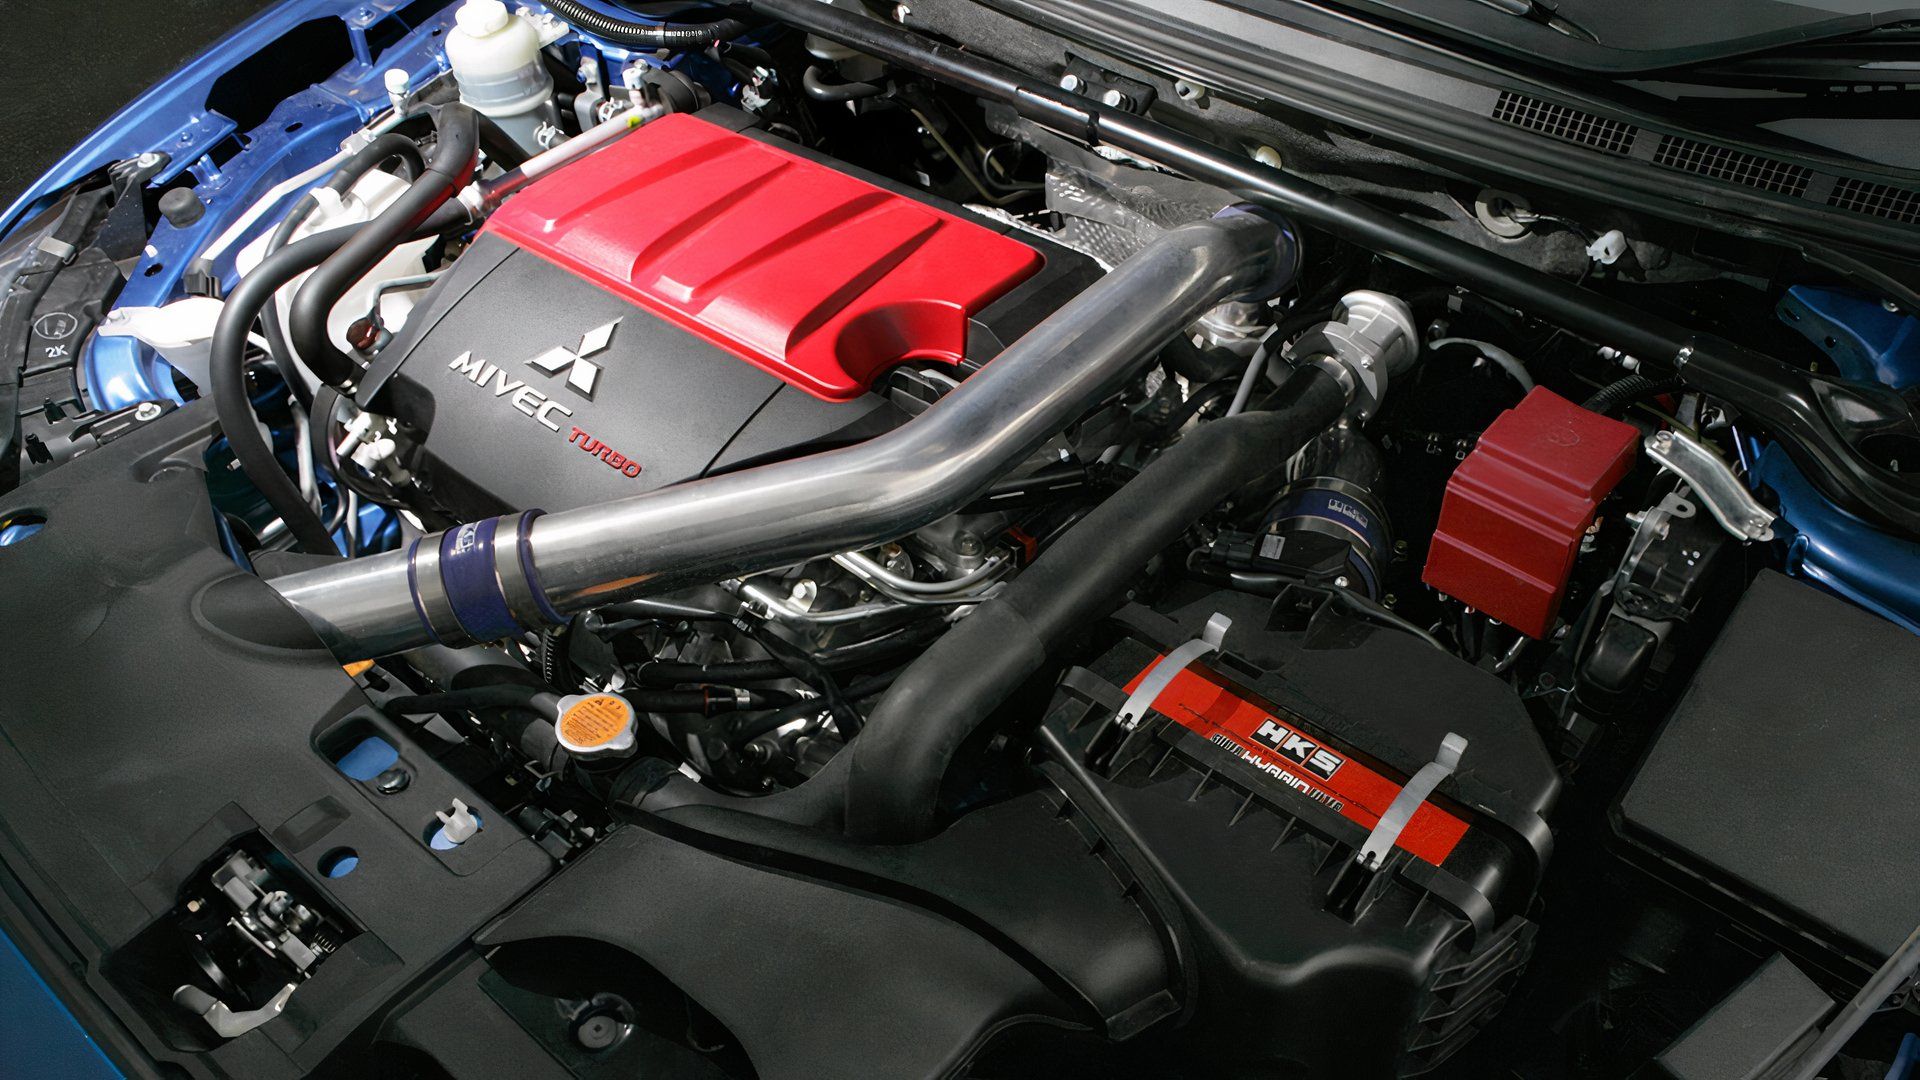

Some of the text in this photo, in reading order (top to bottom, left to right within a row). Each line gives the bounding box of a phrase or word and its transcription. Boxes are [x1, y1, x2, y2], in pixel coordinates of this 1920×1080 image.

[448, 350, 642, 478] MIVEC TURBO
[1256, 720, 1342, 776] HKS
